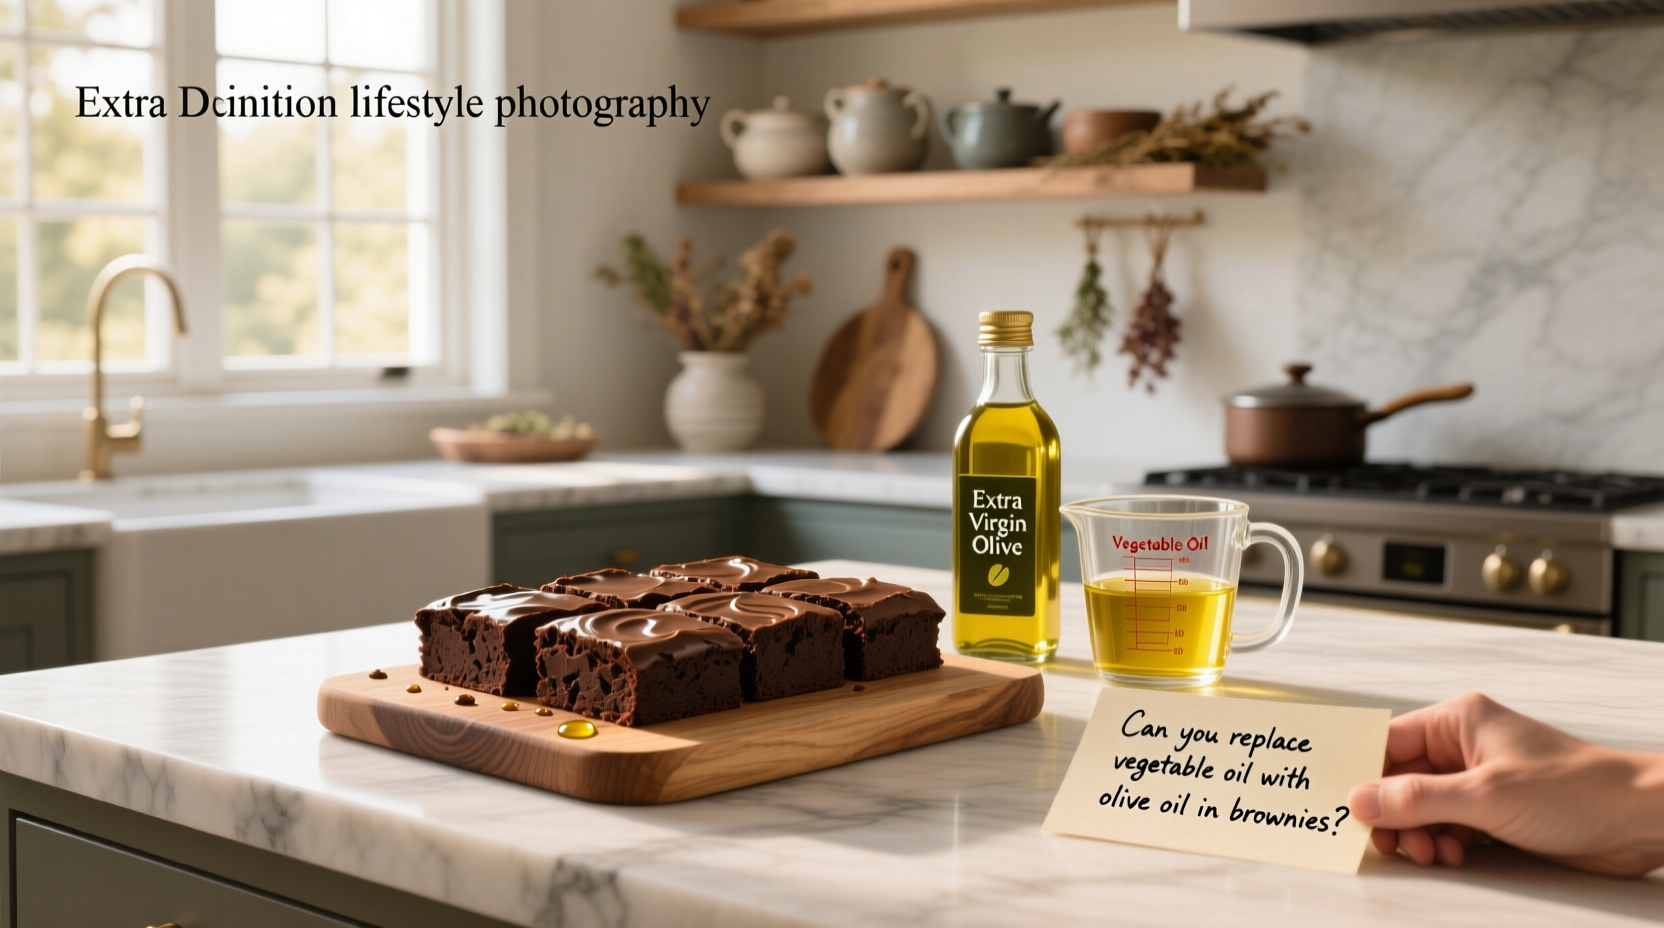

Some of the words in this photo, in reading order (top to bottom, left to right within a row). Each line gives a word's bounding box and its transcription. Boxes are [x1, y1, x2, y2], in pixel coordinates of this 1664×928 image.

[973, 489, 1022, 509] Extra
[968, 512, 1027, 538] Virgin
[972, 535, 1023, 556] Olive
[1112, 535, 1183, 553] Vegetable
[1187, 536, 1208, 551] Oil
[1121, 709, 1168, 738] Can
[1174, 727, 1219, 752] you
[1229, 726, 1313, 758] replace
[1114, 754, 1214, 782] vegetable
[1224, 762, 1253, 784] oil
[1261, 766, 1310, 790] with
[1099, 784, 1151, 810] olive
[1160, 792, 1191, 815] oil
[1197, 797, 1219, 818] in
[1229, 797, 1350, 836] brownies?
